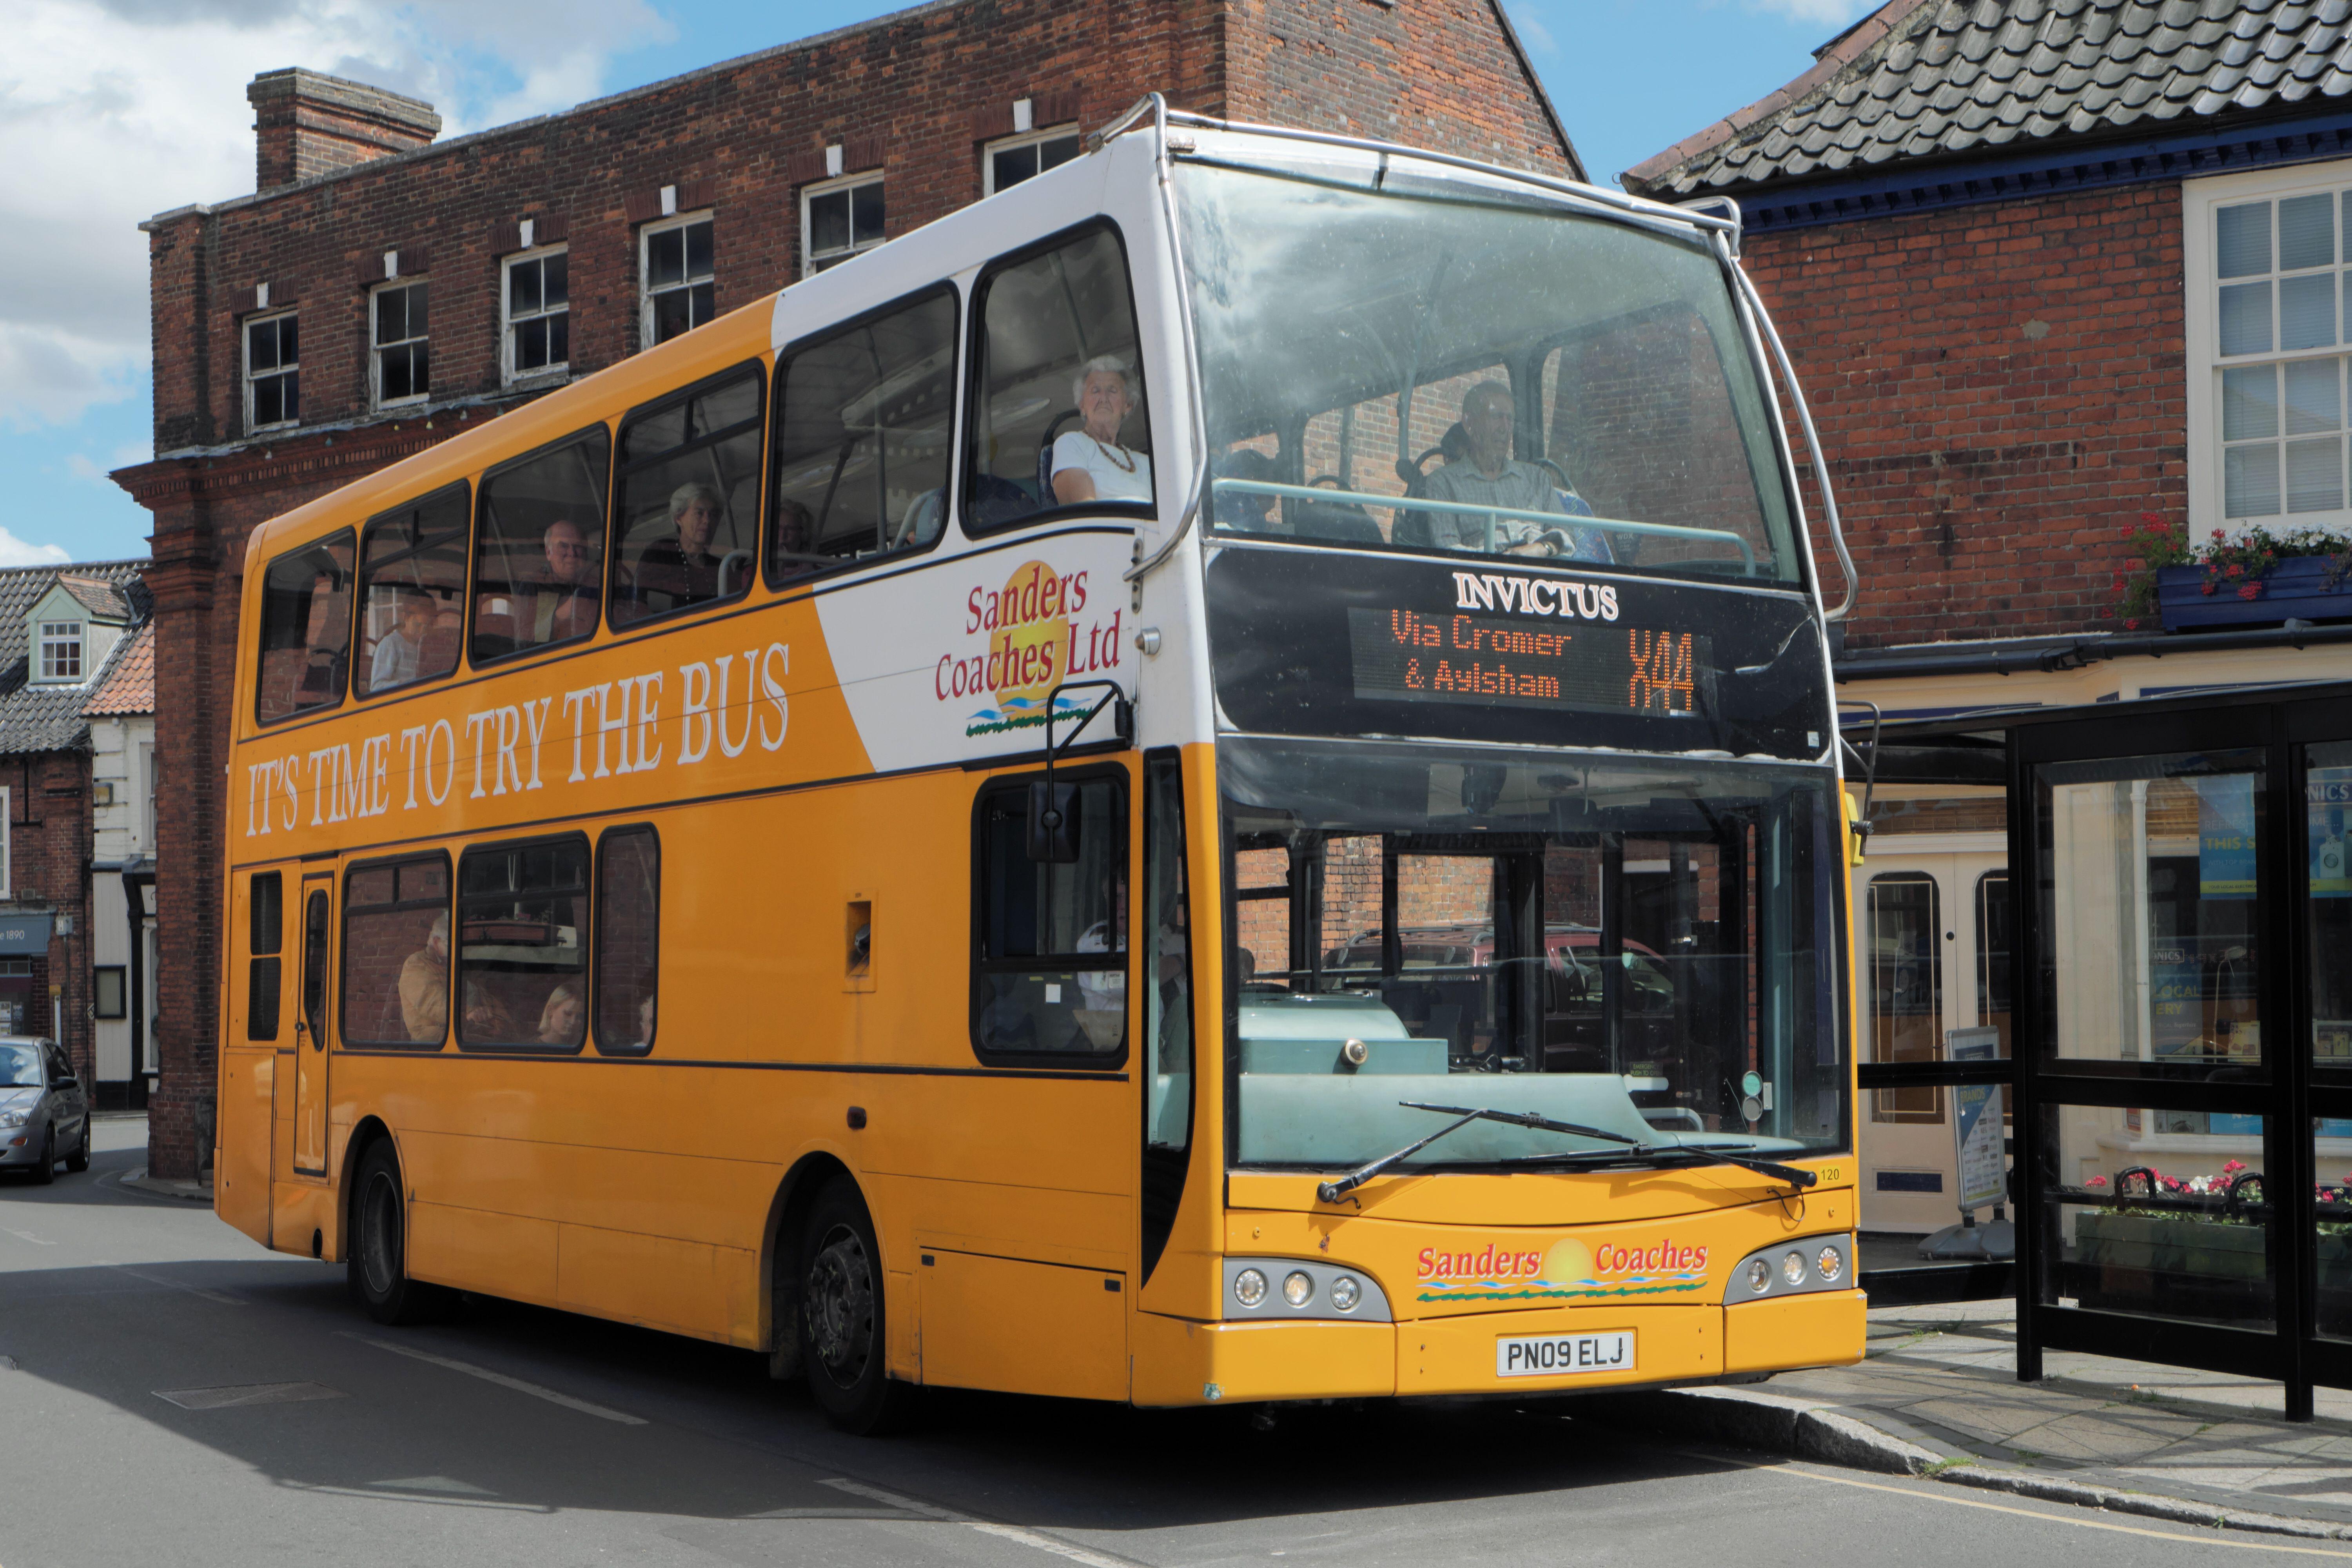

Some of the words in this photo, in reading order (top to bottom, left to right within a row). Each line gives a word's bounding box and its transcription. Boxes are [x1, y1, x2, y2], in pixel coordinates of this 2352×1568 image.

[967, 565, 1088, 635] Sanders
[1453, 573, 1619, 621] INVICTUS
[1392, 609, 1441, 647] Via
[1453, 615, 1571, 657] Cromer
[935, 633, 1054, 701] Coaches
[1066, 608, 1121, 675] Ltd
[1630, 629, 1693, 710] X44
[1405, 659, 1424, 689] &
[1435, 660, 1559, 698] Aylsham
[247, 755, 299, 837] IT'S
[309, 733, 390, 825] TIME
[401, 718, 454, 809] TO
[466, 695, 552, 799] TRY
[563, 670, 663, 783] THE
[677, 642, 789, 765] BUS
[2205, 819, 2253, 830] REFRESH
[2205, 837, 2241, 851] THIS
[6, 930, 25, 940] 1890
[2154, 985, 2200, 998] LOCAL
[1960, 1087, 1985, 1103] BRANDS
[1821, 1169, 1839, 1180] 120
[1417, 1244, 1541, 1279] Sanders
[1597, 1238, 1708, 1274] Coaches
[1508, 1341, 1570, 1370] PN09
[1579, 1337, 1624, 1366] ELJ
